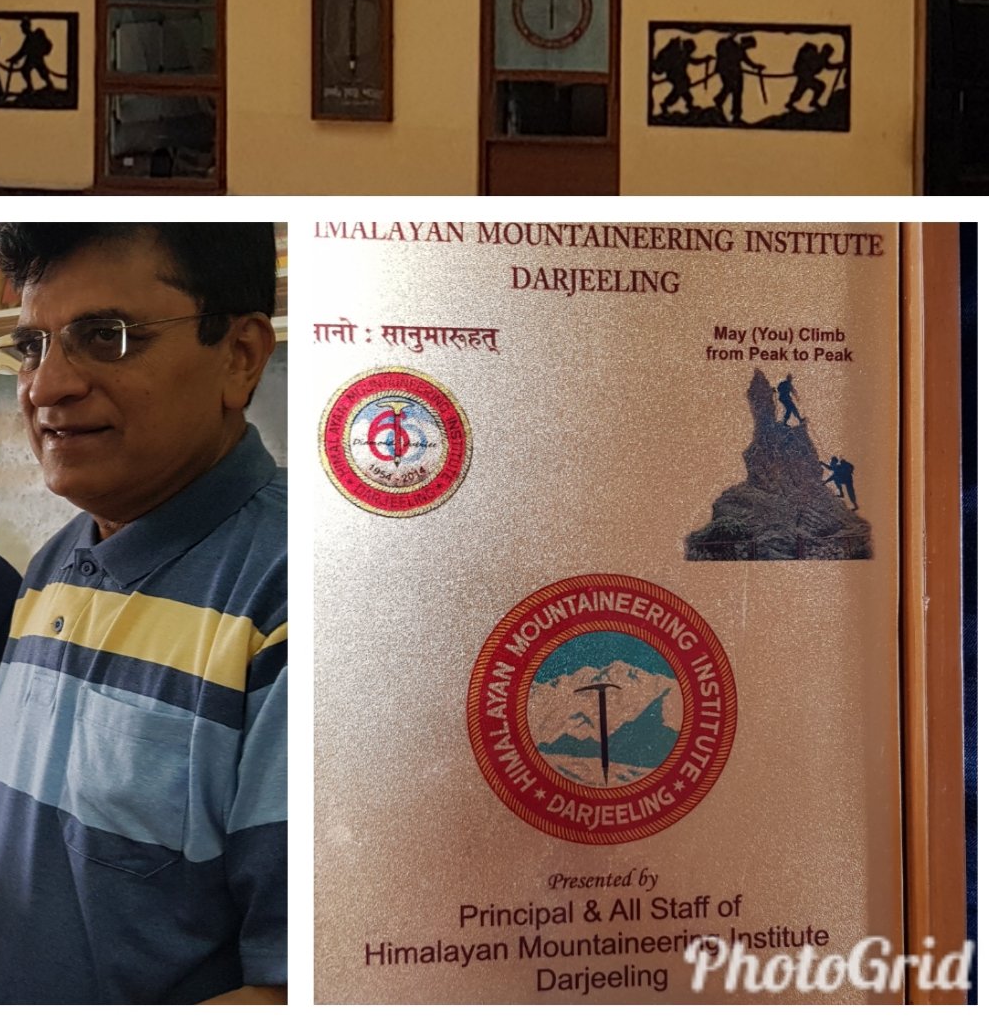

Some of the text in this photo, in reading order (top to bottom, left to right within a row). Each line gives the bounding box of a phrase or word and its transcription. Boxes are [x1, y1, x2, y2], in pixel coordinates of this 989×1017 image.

[476, 222, 734, 254] MOUNTAINEERING
[743, 230, 885, 257] INSTITUTE
[511, 265, 681, 297] DARJEELING
[714, 326, 845, 344] May (You) Climb
[706, 346, 853, 362] from Peak to Peak
[369, 464, 392, 481] 1954
[487, 590, 720, 792] HIMALAYAN MOUNTAINEERING INSTITUTE
[547, 786, 676, 831] DARJEELING
[548, 867, 659, 892] Presented by
[460, 894, 743, 930] Principal & All Staff of
[365, 925, 830, 968] Himalayan Mountaineering Institute
[537, 965, 669, 995] Darjeeling
